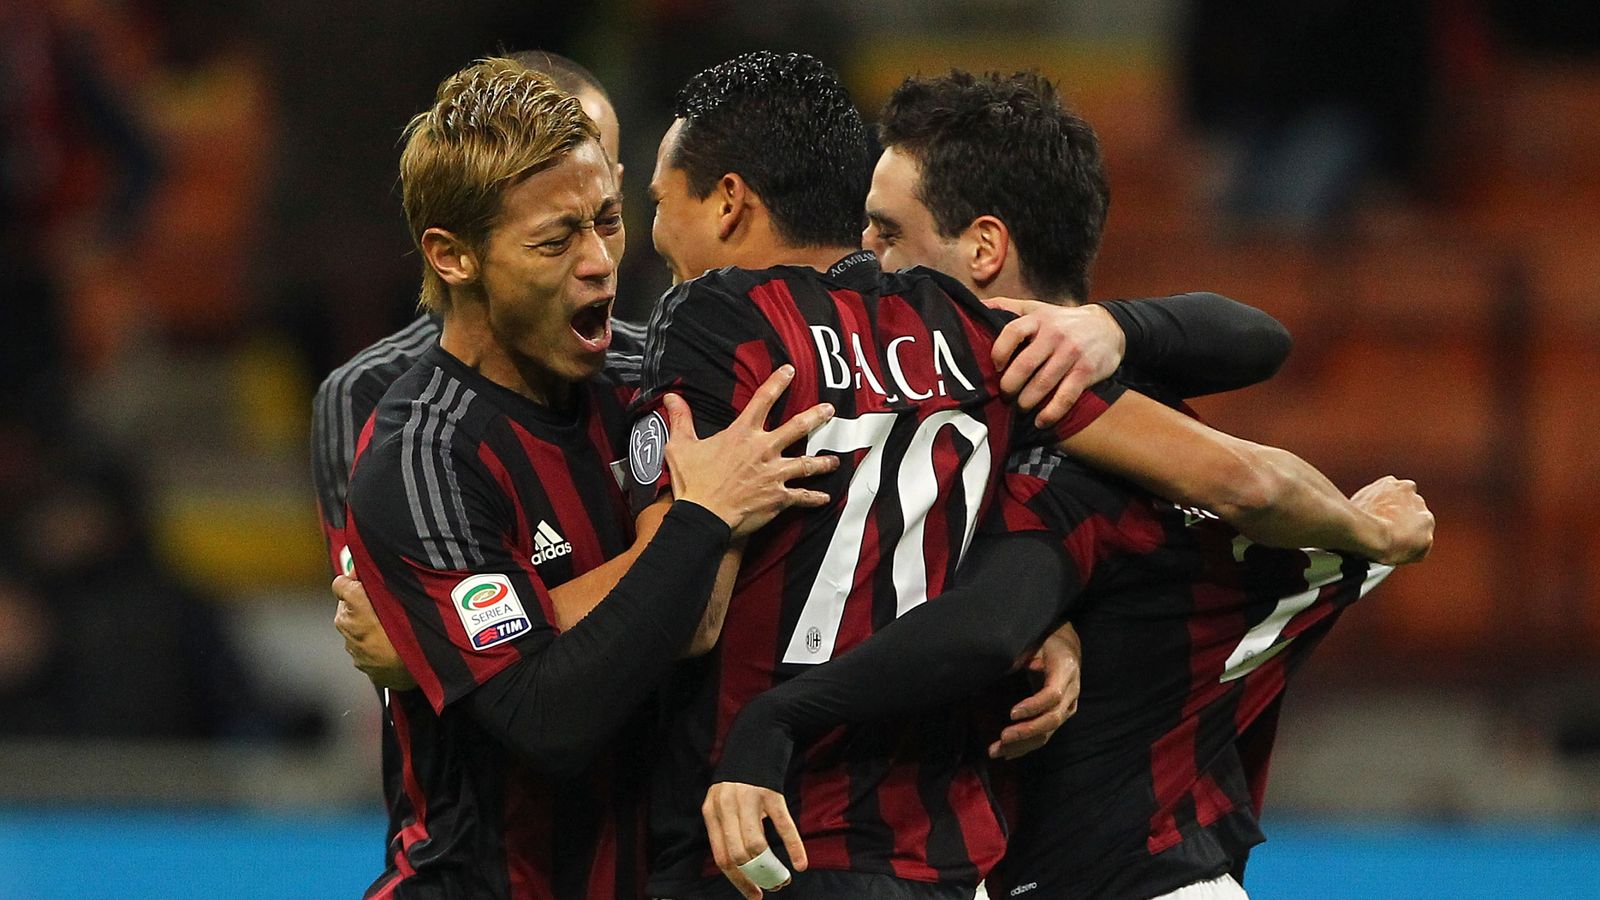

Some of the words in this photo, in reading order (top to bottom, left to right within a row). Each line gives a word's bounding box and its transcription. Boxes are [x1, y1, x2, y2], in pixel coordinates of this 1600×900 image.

[831, 263, 846, 278] AC
[845, 252, 876, 267] MILAN
[782, 409, 992, 664] 70
[531, 541, 573, 566] adidas
[471, 606, 504, 626] SERIE
[504, 603, 514, 614] A
[496, 619, 523, 637] TIM
[1010, 882, 1038, 897] adizero
